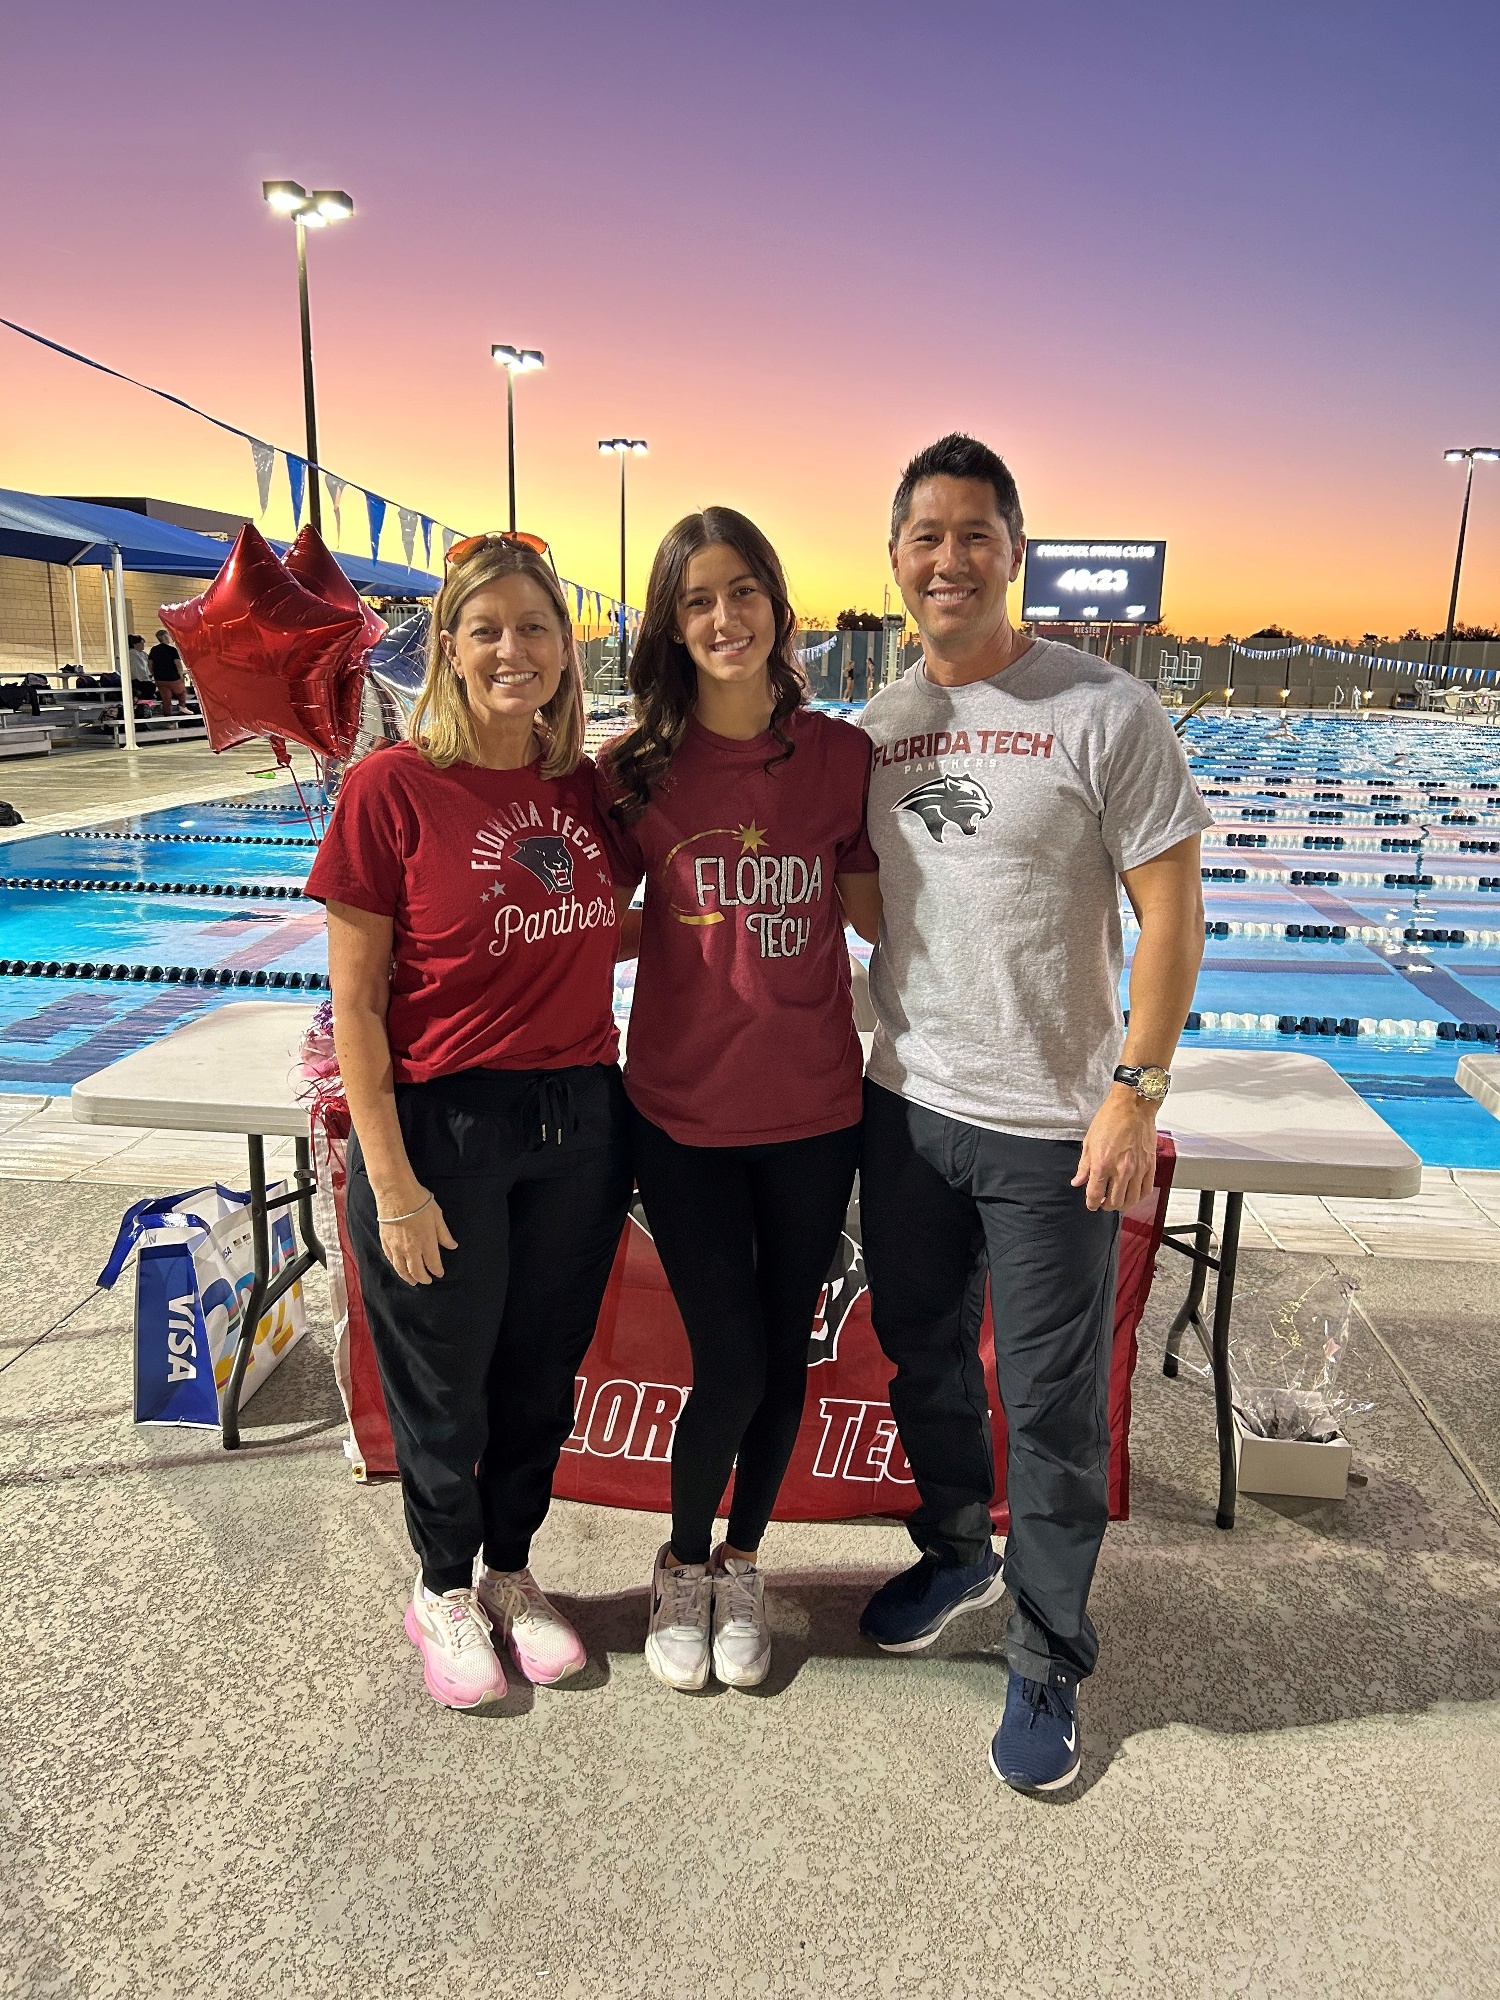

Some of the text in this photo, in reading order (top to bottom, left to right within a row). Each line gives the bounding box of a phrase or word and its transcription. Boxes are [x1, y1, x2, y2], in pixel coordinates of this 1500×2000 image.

[1073, 626, 1101, 634] RIESTER
[872, 730, 1054, 772] FLORIDA TECH
[904, 758, 997, 775] PANTHERS
[470, 800, 601, 870] FLORIDA TECH
[693, 855, 823, 907] FLORIDA
[488, 894, 616, 957] Panthers
[745, 904, 812, 959] TECH
[167, 1293, 197, 1383] VISA
